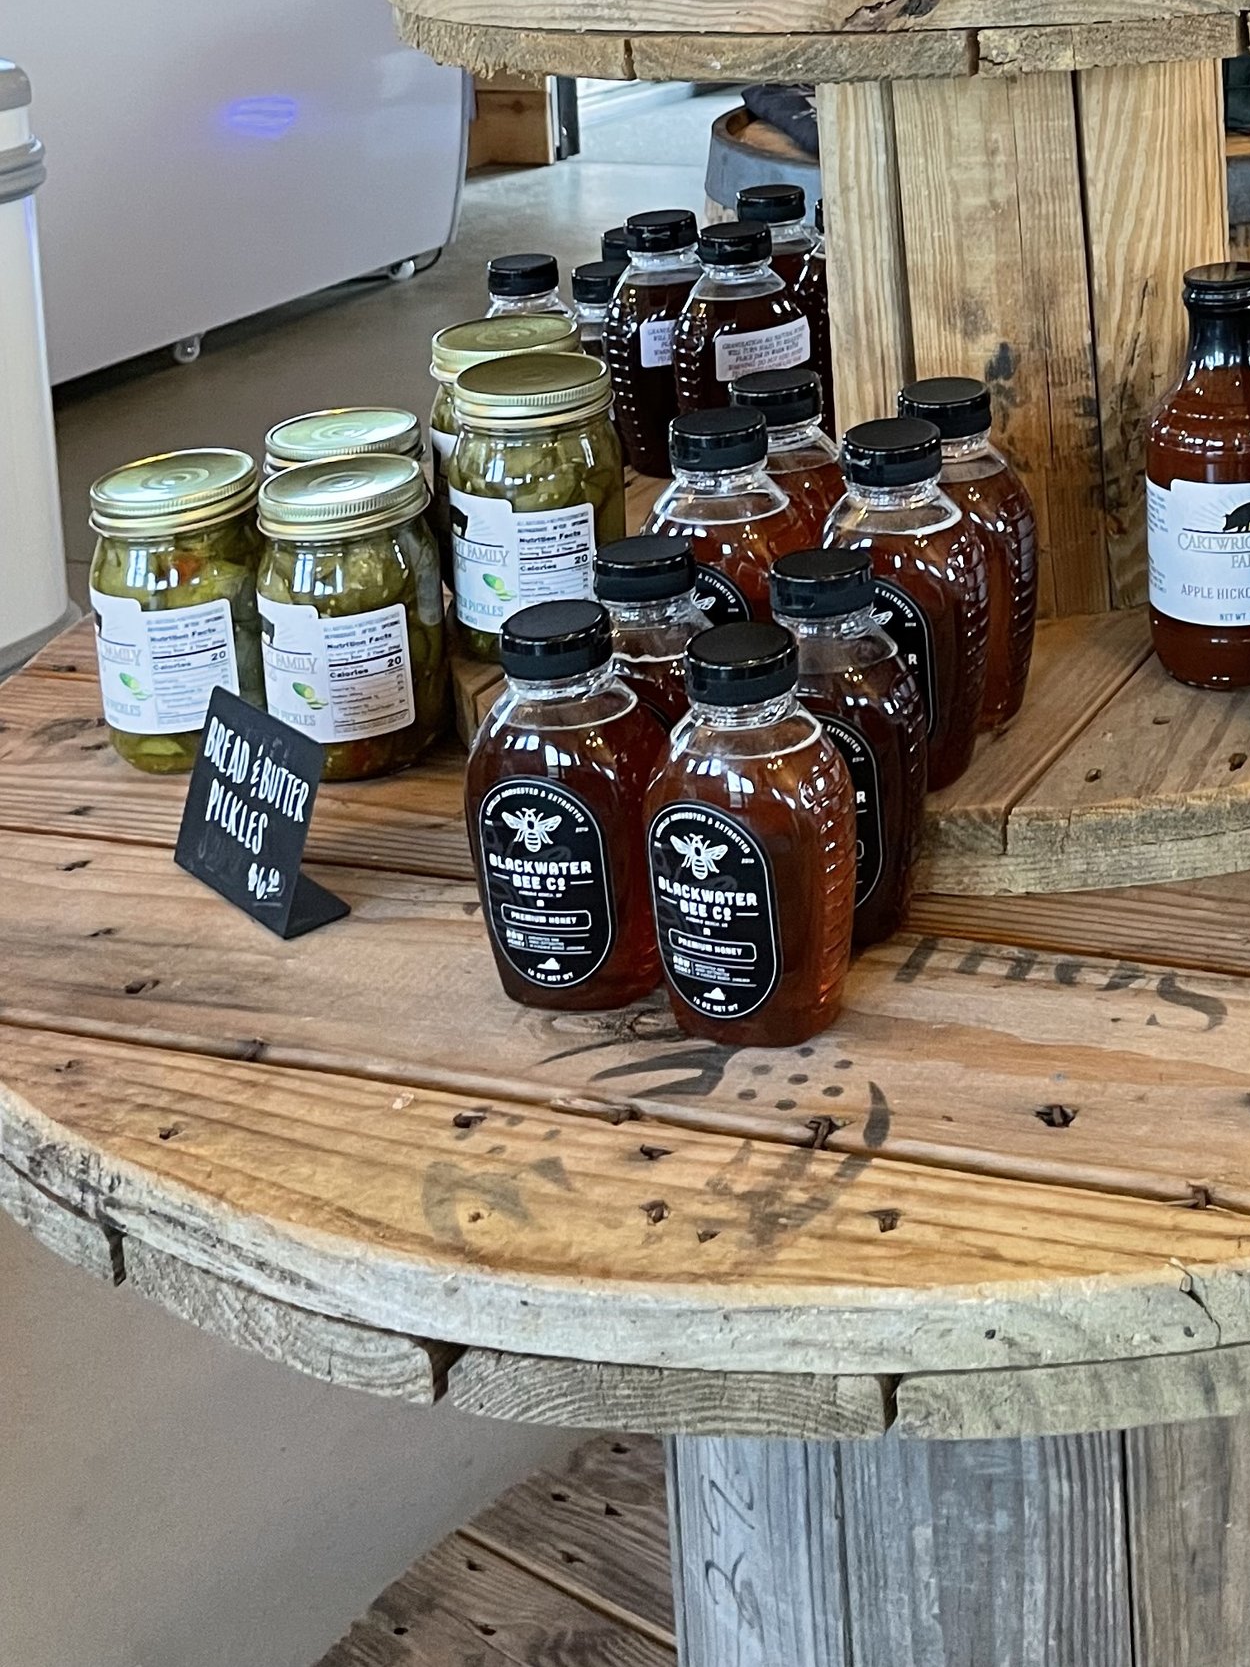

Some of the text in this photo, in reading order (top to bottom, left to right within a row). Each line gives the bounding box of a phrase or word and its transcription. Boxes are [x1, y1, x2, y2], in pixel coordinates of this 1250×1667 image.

[467, 545, 509, 567] FAMILY
[520, 554, 588, 572] Calories 20
[1181, 584, 1213, 599] APPLE
[468, 601, 504, 617] PICKLES
[327, 633, 392, 649] Nutrition Facts
[211, 650, 226, 661] 20
[276, 655, 318, 675] FAMILY
[330, 656, 402, 678] Calories 20
[281, 711, 316, 727] PICKLES
[826, 725, 861, 753] EXTRACTED
[204, 716, 250, 784] BREAD
[259, 756, 310, 823] BUTTER
[205, 778, 268, 855] PICKLES
[489, 853, 592, 874] BLACKWATER
[512, 874, 542, 889] BEE
[658, 875, 758, 907] BLACKWATER
[510, 911, 577, 924] PREMIUM HONEY
[679, 899, 708, 918] BEE
[678, 936, 742, 956] PREMIUM HONEY
